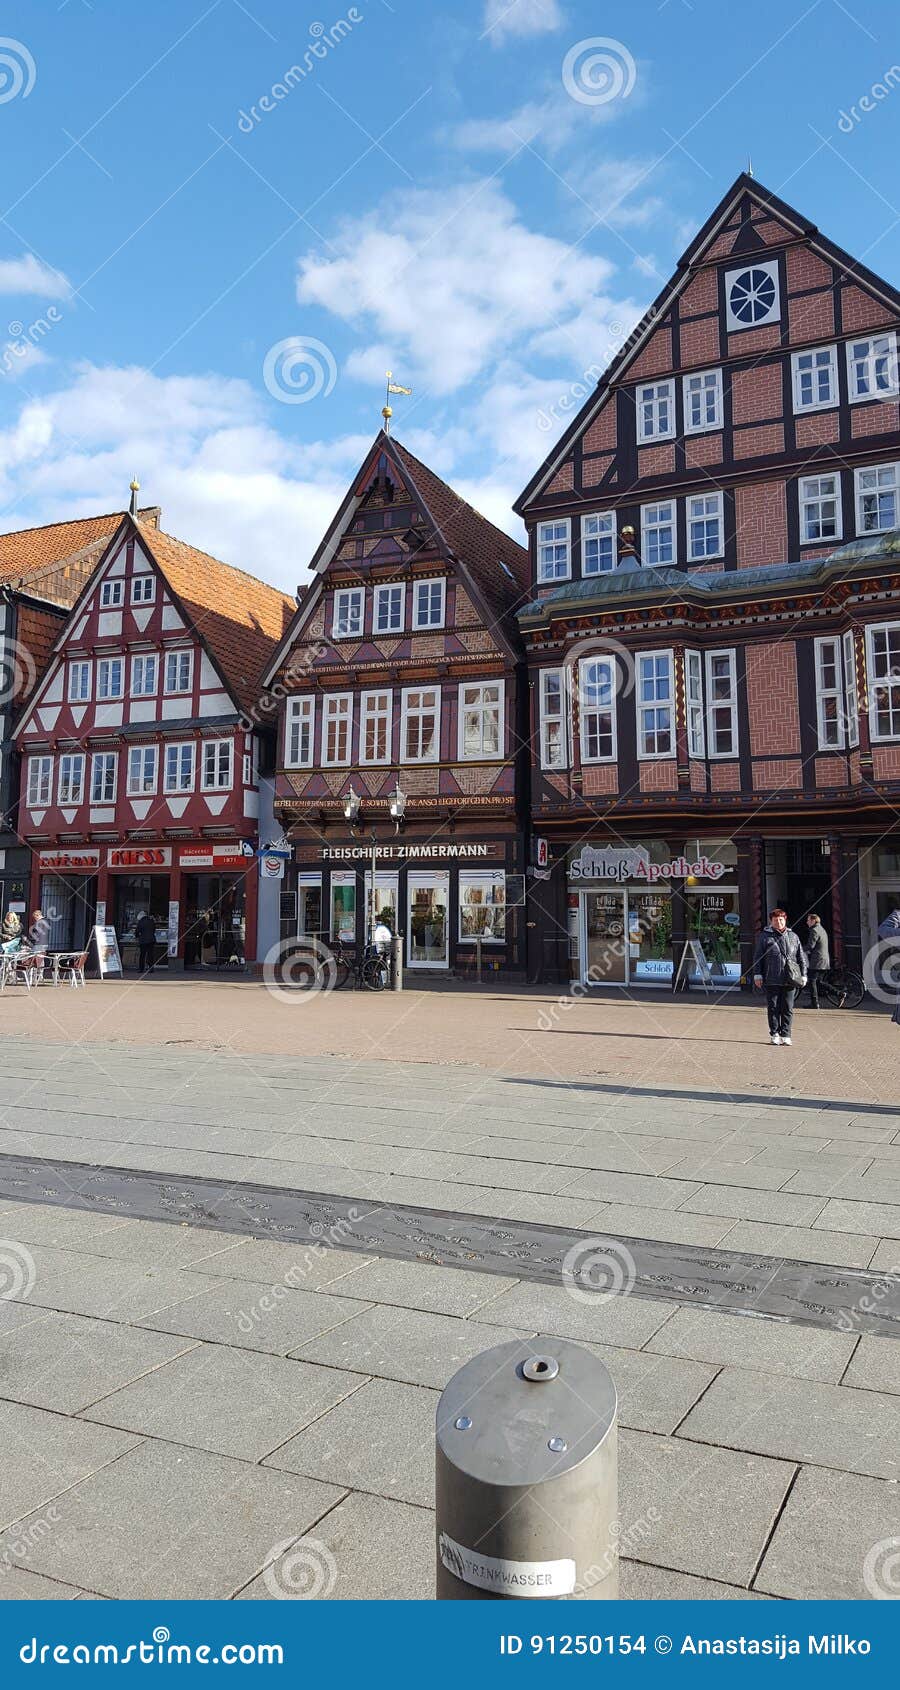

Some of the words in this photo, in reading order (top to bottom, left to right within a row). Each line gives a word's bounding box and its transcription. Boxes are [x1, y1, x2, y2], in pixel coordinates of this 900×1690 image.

[397, 844, 487, 857] ZIMMERMANN
[571, 860, 629, 880] Schloß
[636, 858, 722, 880] Apotheke
